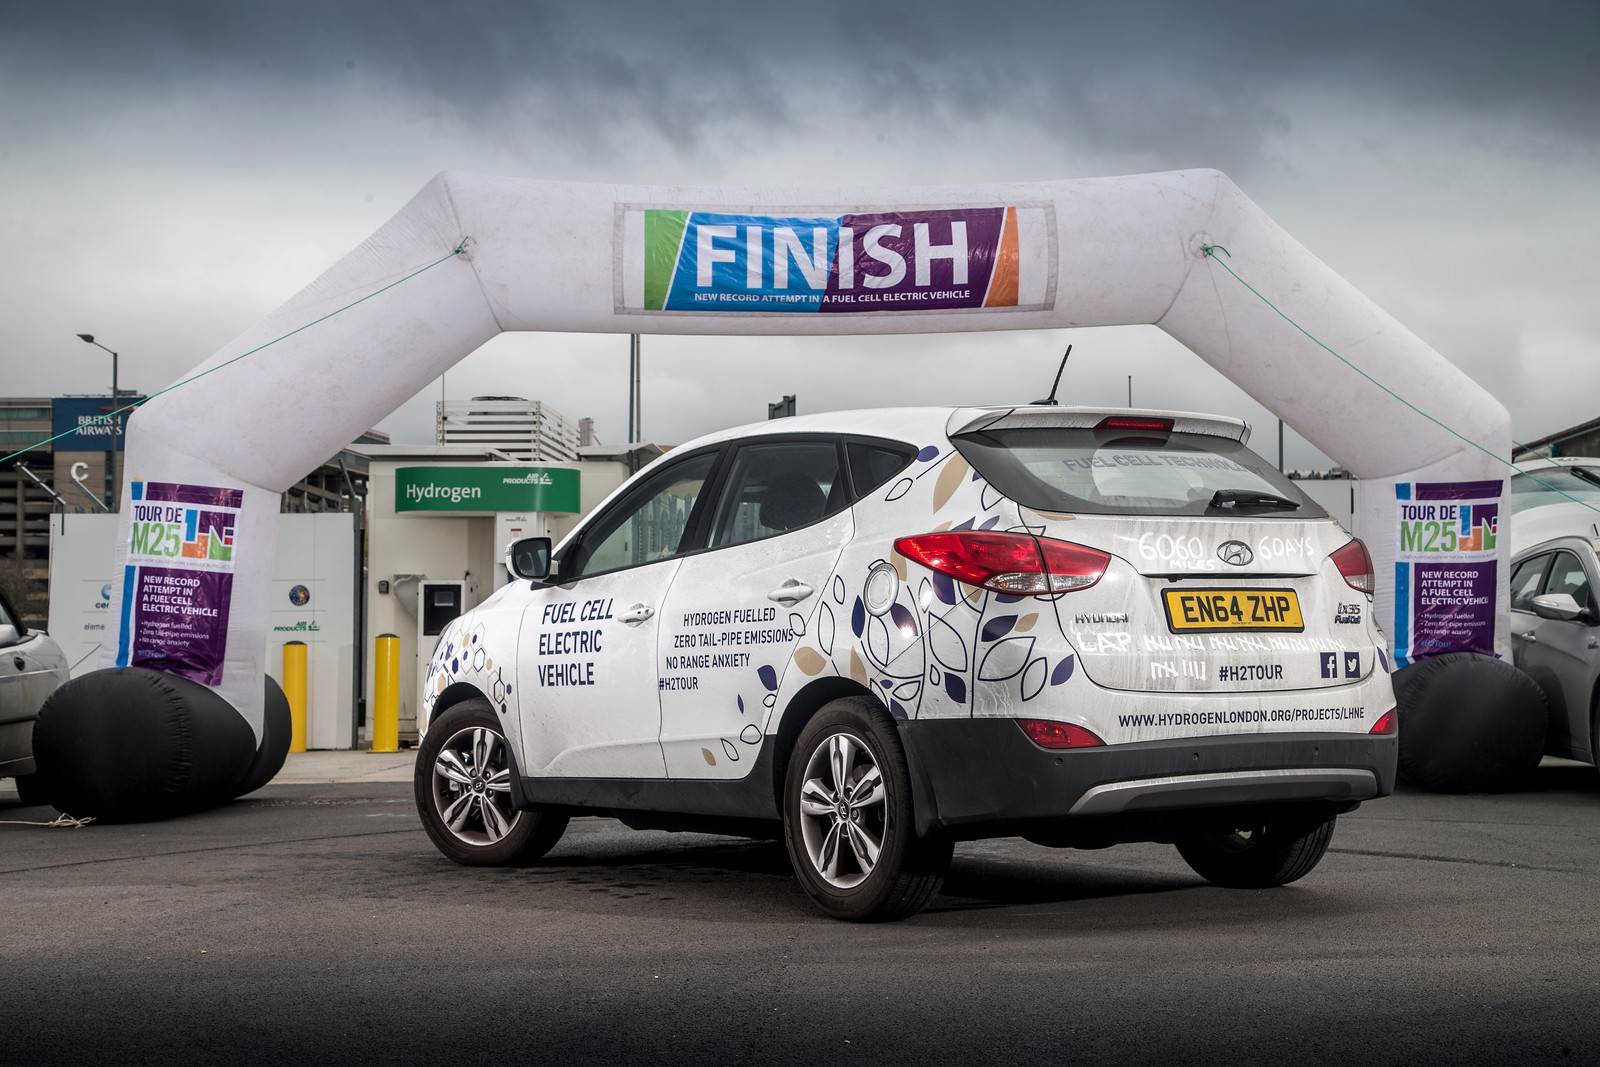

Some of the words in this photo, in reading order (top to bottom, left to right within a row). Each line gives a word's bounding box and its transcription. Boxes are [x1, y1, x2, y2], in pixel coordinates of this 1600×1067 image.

[697, 221, 969, 290] FINISH
[694, 293, 718, 302] NEW
[720, 293, 760, 302] RECORD
[762, 295, 807, 303] ATTEMPT
[809, 295, 819, 303] IN
[823, 295, 830, 303] A
[832, 295, 856, 303] FUEL
[858, 294, 881, 302] CELL
[883, 292, 928, 302] ELECTRIC
[929, 290, 970, 300] VEHICLE
[75, 426, 122, 435] AIRWAS
[71, 461, 89, 481] C
[1063, 455, 1116, 472] FUEL
[1113, 454, 1164, 466] CELL
[406, 483, 481, 503] Hydrogen
[134, 505, 162, 522] TOUR
[165, 507, 183, 524] DE
[1401, 505, 1436, 521] TOUR
[1440, 505, 1457, 520] DE
[131, 522, 180, 557] M25
[1400, 521, 1457, 552] M25
[1138, 532, 1203, 561] 6060
[1169, 559, 1216, 571] MILES
[143, 575, 163, 584] NEW
[164, 577, 200, 587] RECORD
[1421, 571, 1442, 579] NEW
[1443, 571, 1479, 579] RECORD
[143, 584, 180, 594] ATTEMPT
[182, 588, 193, 596] IN
[1421, 580, 1461, 588] ATTEMPT
[1463, 580, 1473, 588] IN
[142, 594, 149, 602] A
[150, 594, 169, 603] FUEL
[171, 596, 193, 605] CELL
[1421, 589, 1428, 597] A
[1429, 589, 1451, 597] FUEL
[1453, 589, 1474, 597] CELL
[1421, 597, 1462, 606] ELECTRIC
[142, 603, 180, 614] ELECTRIC
[181, 606, 218, 617] VEHICLE
[541, 602, 577, 625] FUEL
[580, 598, 613, 622] CELL
[683, 610, 731, 626] HYDROGEN
[734, 607, 776, 623] FUELLED
[1180, 595, 1244, 623] EN64
[1247, 595, 1290, 622] ZHP
[1074, 612, 1129, 624] HYUNDAI
[538, 629, 603, 656] ELECTRIC
[674, 633, 696, 648] ZERO
[698, 631, 742, 647] TAIL-PIPE
[744, 628, 794, 645] EMISSIONS
[1076, 631, 1132, 653] LAP
[666, 656, 678, 669] NO
[680, 654, 710, 669] RANGE
[712, 653, 750, 668] ANXIETY
[538, 662, 594, 687] VEHICLE
[1219, 664, 1283, 681] #H2TOUR
[659, 676, 699, 691] #H2TOUR
[1118, 707, 1364, 728] WWW.HYDROGENLONDON.ORG/PROJECTS/LHNE
